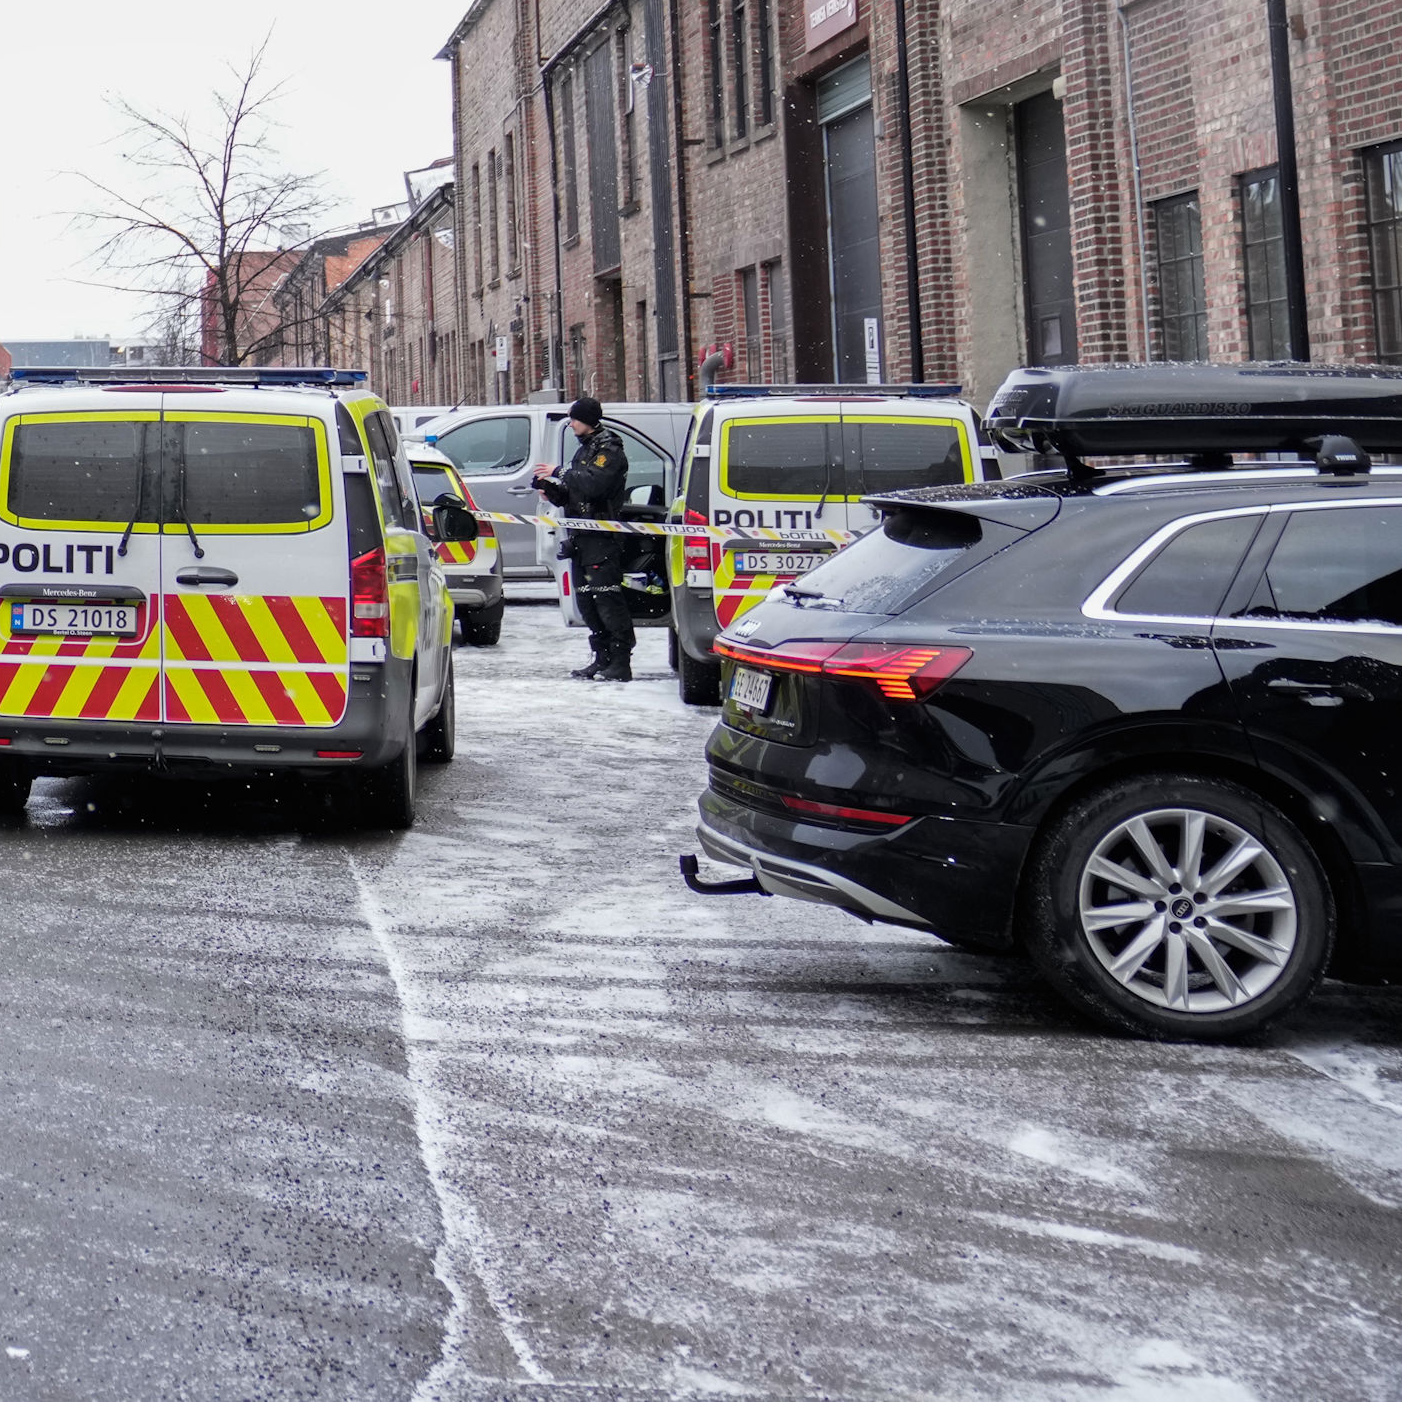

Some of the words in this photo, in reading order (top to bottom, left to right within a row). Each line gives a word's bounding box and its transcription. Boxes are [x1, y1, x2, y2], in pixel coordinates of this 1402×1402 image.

[714, 509, 812, 530] POLITI
[748, 555, 768, 569] DS
[42, 588, 97, 597] Mercedes-Benz
[14, 618, 21, 626] N
[32, 608, 58, 627] DS
[67, 608, 127, 629] 21018
